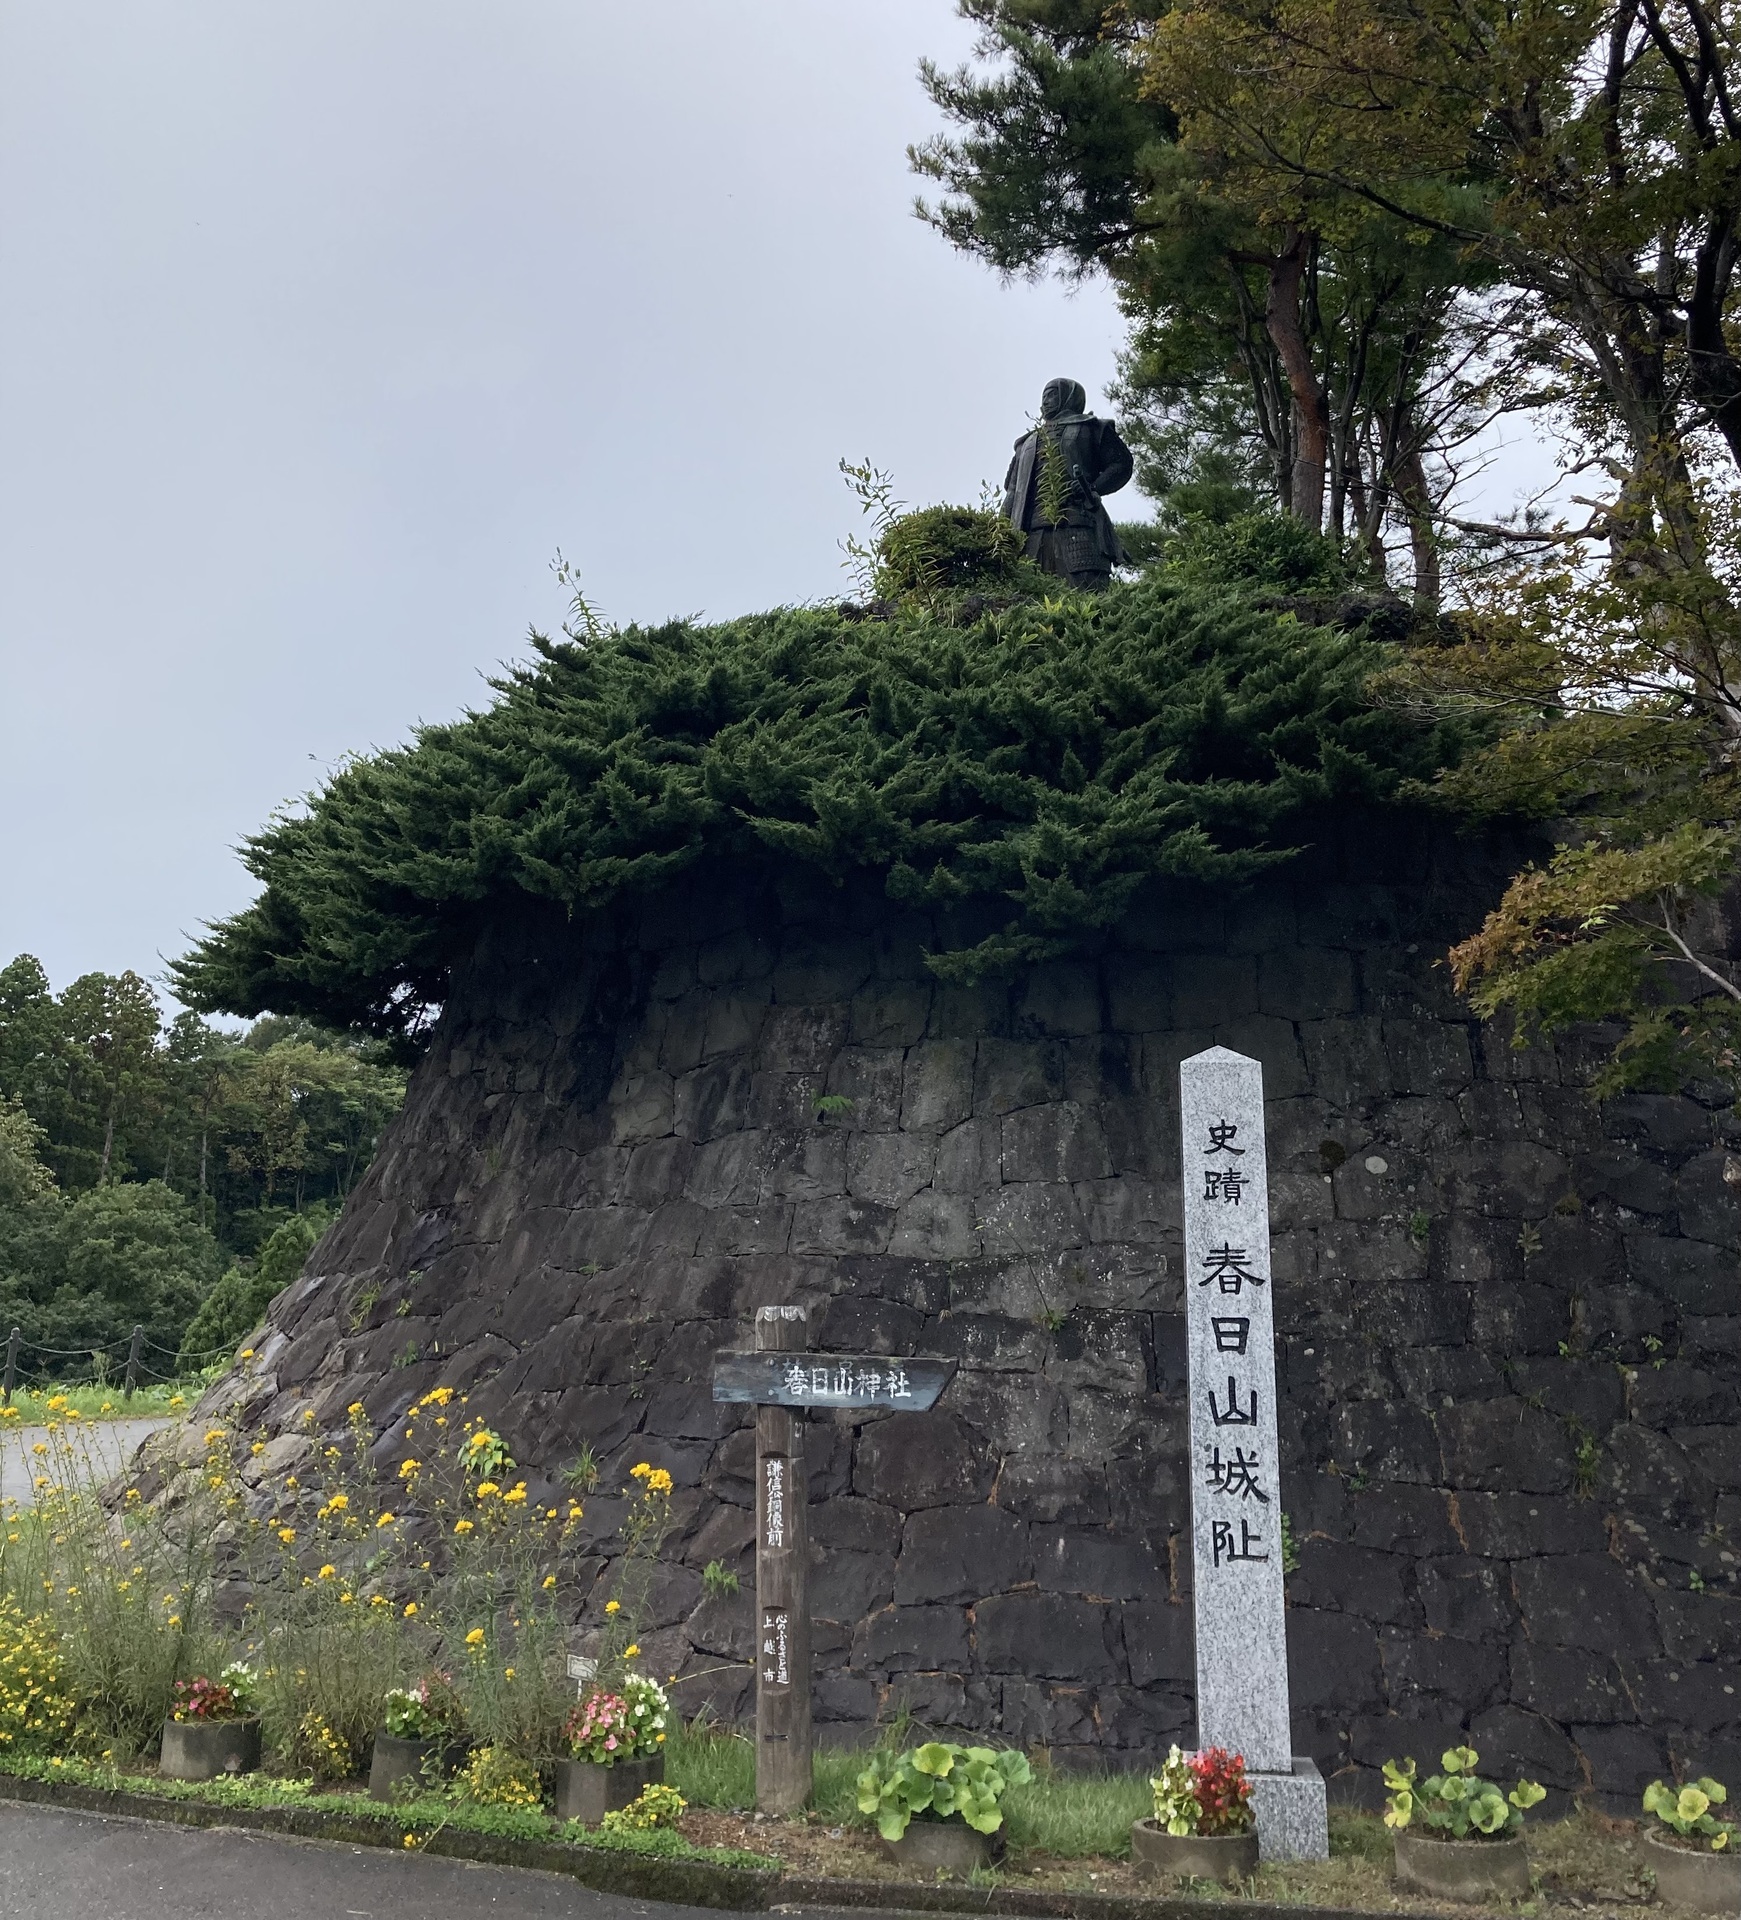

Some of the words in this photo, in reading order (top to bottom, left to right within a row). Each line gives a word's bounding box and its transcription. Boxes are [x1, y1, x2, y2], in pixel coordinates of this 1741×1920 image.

[1203, 1119, 1250, 1206] 史蹟
[781, 1365, 912, 1402] 春日山神社
[766, 1460, 784, 1547] 謙信公銅像前
[763, 1614, 777, 1683] 上越市
[775, 1614, 790, 1685] 心のふるさと道
